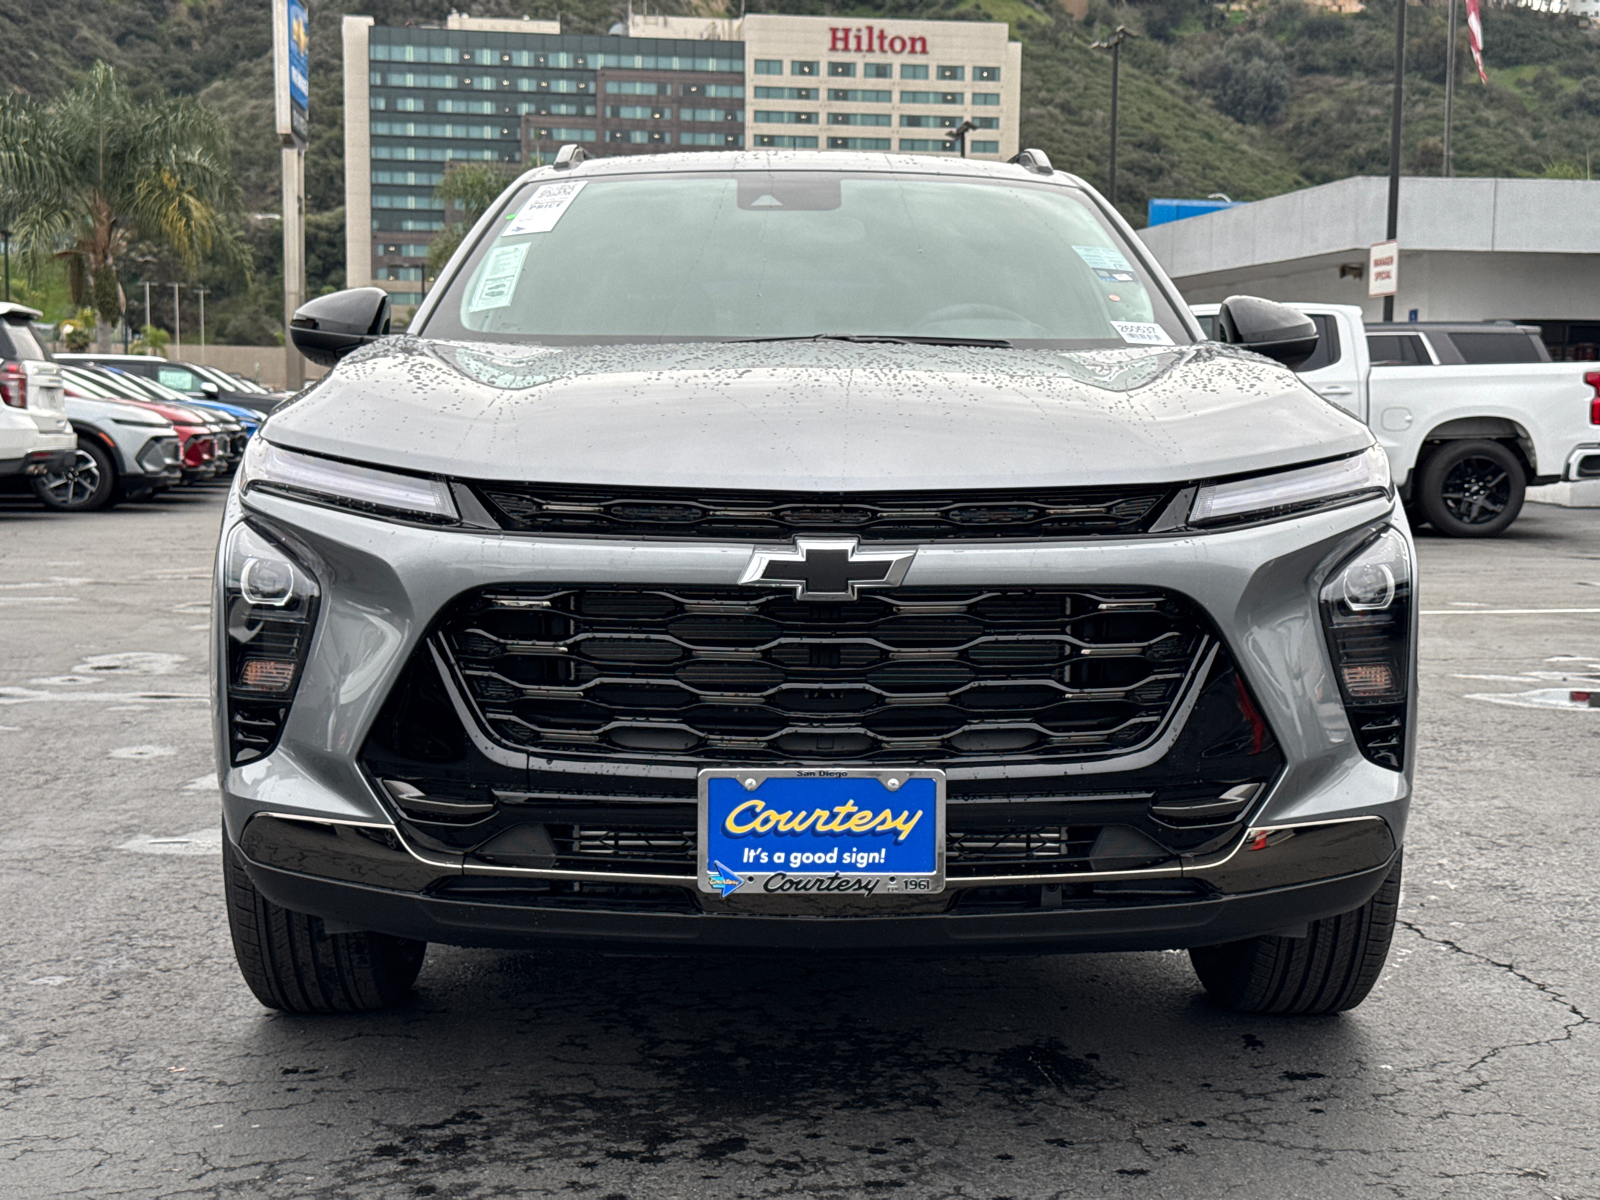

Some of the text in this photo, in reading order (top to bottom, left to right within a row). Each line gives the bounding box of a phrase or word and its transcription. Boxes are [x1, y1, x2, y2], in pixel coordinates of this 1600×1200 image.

[828, 25, 929, 54] Hilton
[818, 770, 848, 778] Diego
[724, 799, 923, 841] Courtesy
[743, 847, 886, 868] It's a good sign!
[763, 872, 881, 897] Courtesy
[903, 879, 930, 890] 1961
